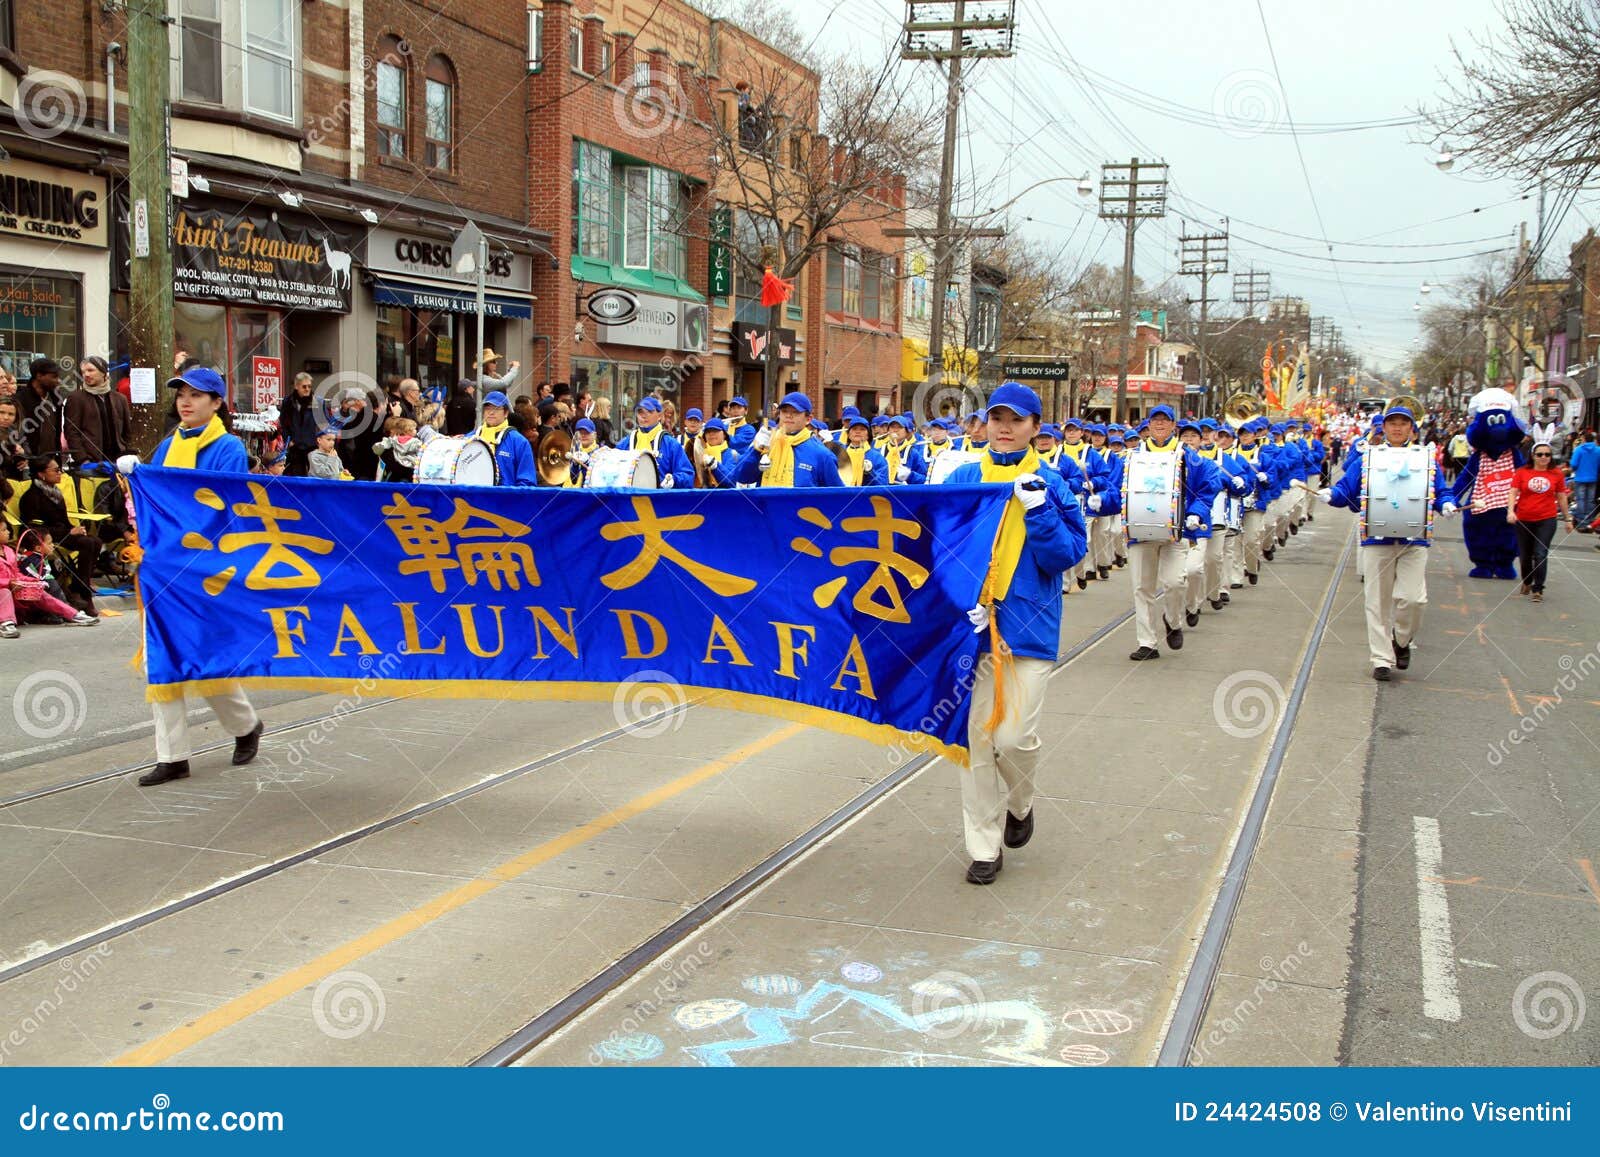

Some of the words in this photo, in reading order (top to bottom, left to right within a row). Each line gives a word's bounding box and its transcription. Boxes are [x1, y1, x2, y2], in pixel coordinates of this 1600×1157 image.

[0, 174, 98, 229] NNING
[24, 220, 81, 239] CREATIONS
[236, 221, 320, 265] Treasures
[395, 238, 452, 269] CORSO
[715, 213, 725, 292] OPICAL
[218, 255, 274, 273] 647-291-2380
[176, 267, 201, 280] WOOL,
[202, 270, 231, 282] ORGANIC
[232, 273, 260, 286] COTTON,
[261, 278, 271, 287] 950
[279, 280, 289, 289] 925
[290, 281, 316, 293] STERLING
[317, 284, 336, 295] SILVER
[7, 286, 29, 300] Hair
[32, 288, 63, 304] Salon
[189, 283, 210, 294] GIFTS
[210, 285, 230, 295] FROM
[231, 287, 252, 297] SOUTH
[256, 290, 280, 301] MERICA
[286, 294, 310, 304] AROUND
[311, 297, 322, 306] THE
[322, 298, 343, 309] WORLD
[413, 294, 450, 308] FASHION
[452, 300, 459, 310] &
[461, 301, 502, 315] LIFETYLE
[0, 303, 49, 318] 47-6311
[258, 362, 277, 375] Sale
[1005, 366, 1020, 375] THE
[1021, 367, 1043, 375] BODY
[1044, 367, 1066, 376] SHOP
[181, 480, 930, 624] 法輪大法
[262, 602, 580, 661] FALUN
[609, 607, 878, 701] DAFA
